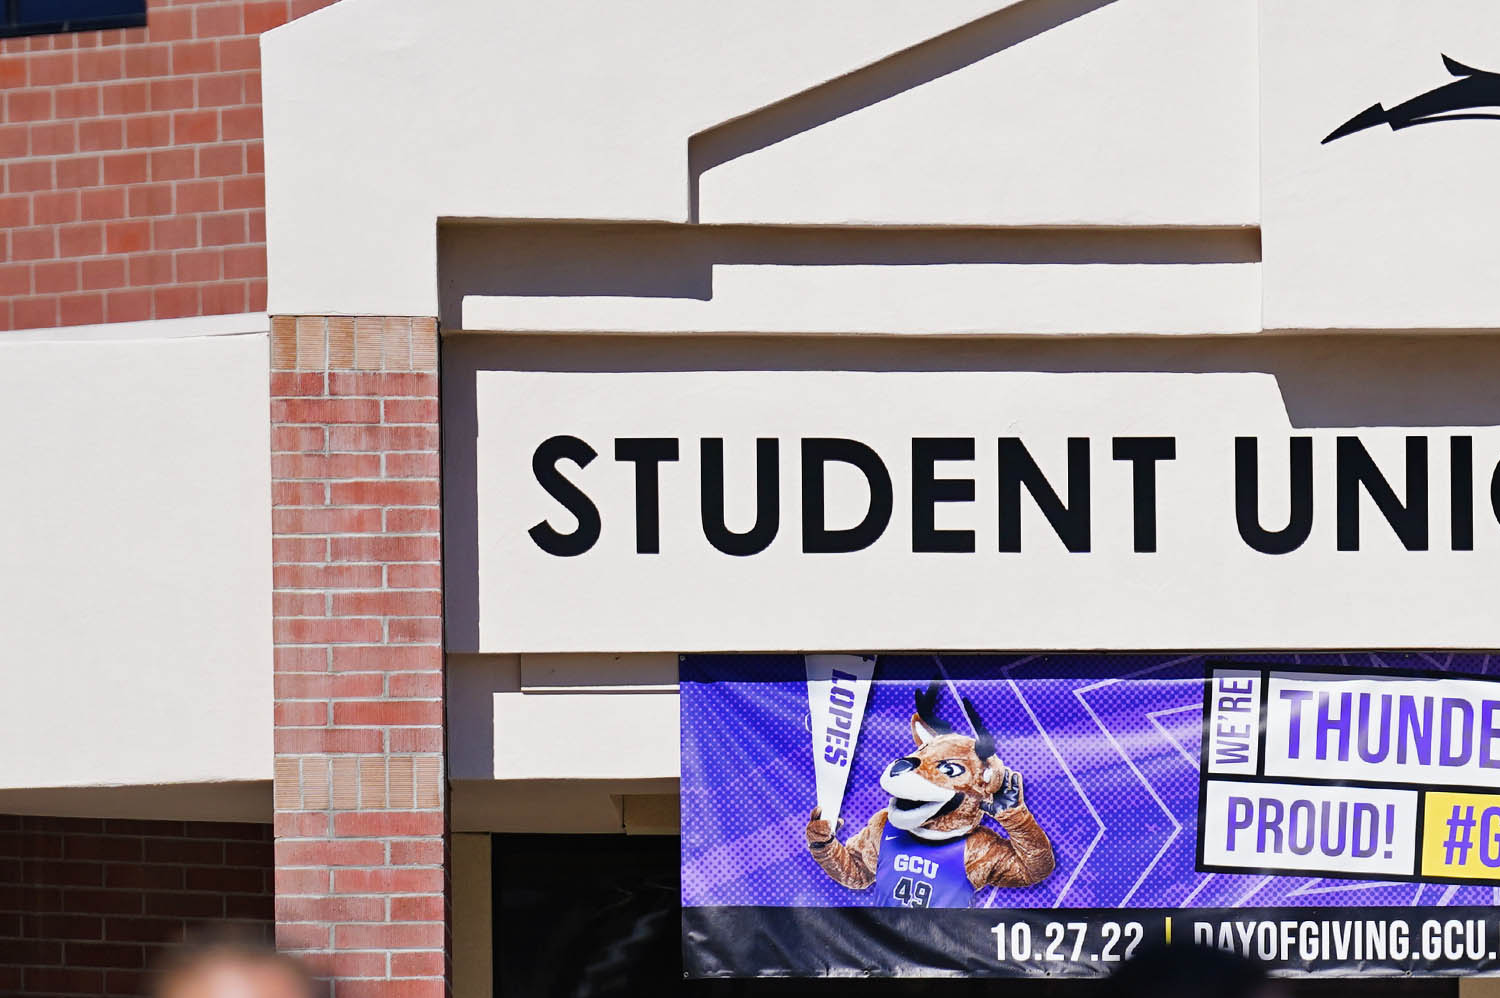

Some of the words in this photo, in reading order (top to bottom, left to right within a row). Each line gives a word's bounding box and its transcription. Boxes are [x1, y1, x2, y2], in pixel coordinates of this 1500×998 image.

[528, 434, 1176, 558] STUDENT
[824, 668, 858, 768] LOPES
[1215, 678, 1253, 765] WE'RE
[1225, 796, 1396, 860] PROUD!
[893, 876, 933, 908] 49
[894, 854, 939, 879] GCU
[990, 921, 1144, 962] 10.27.22
